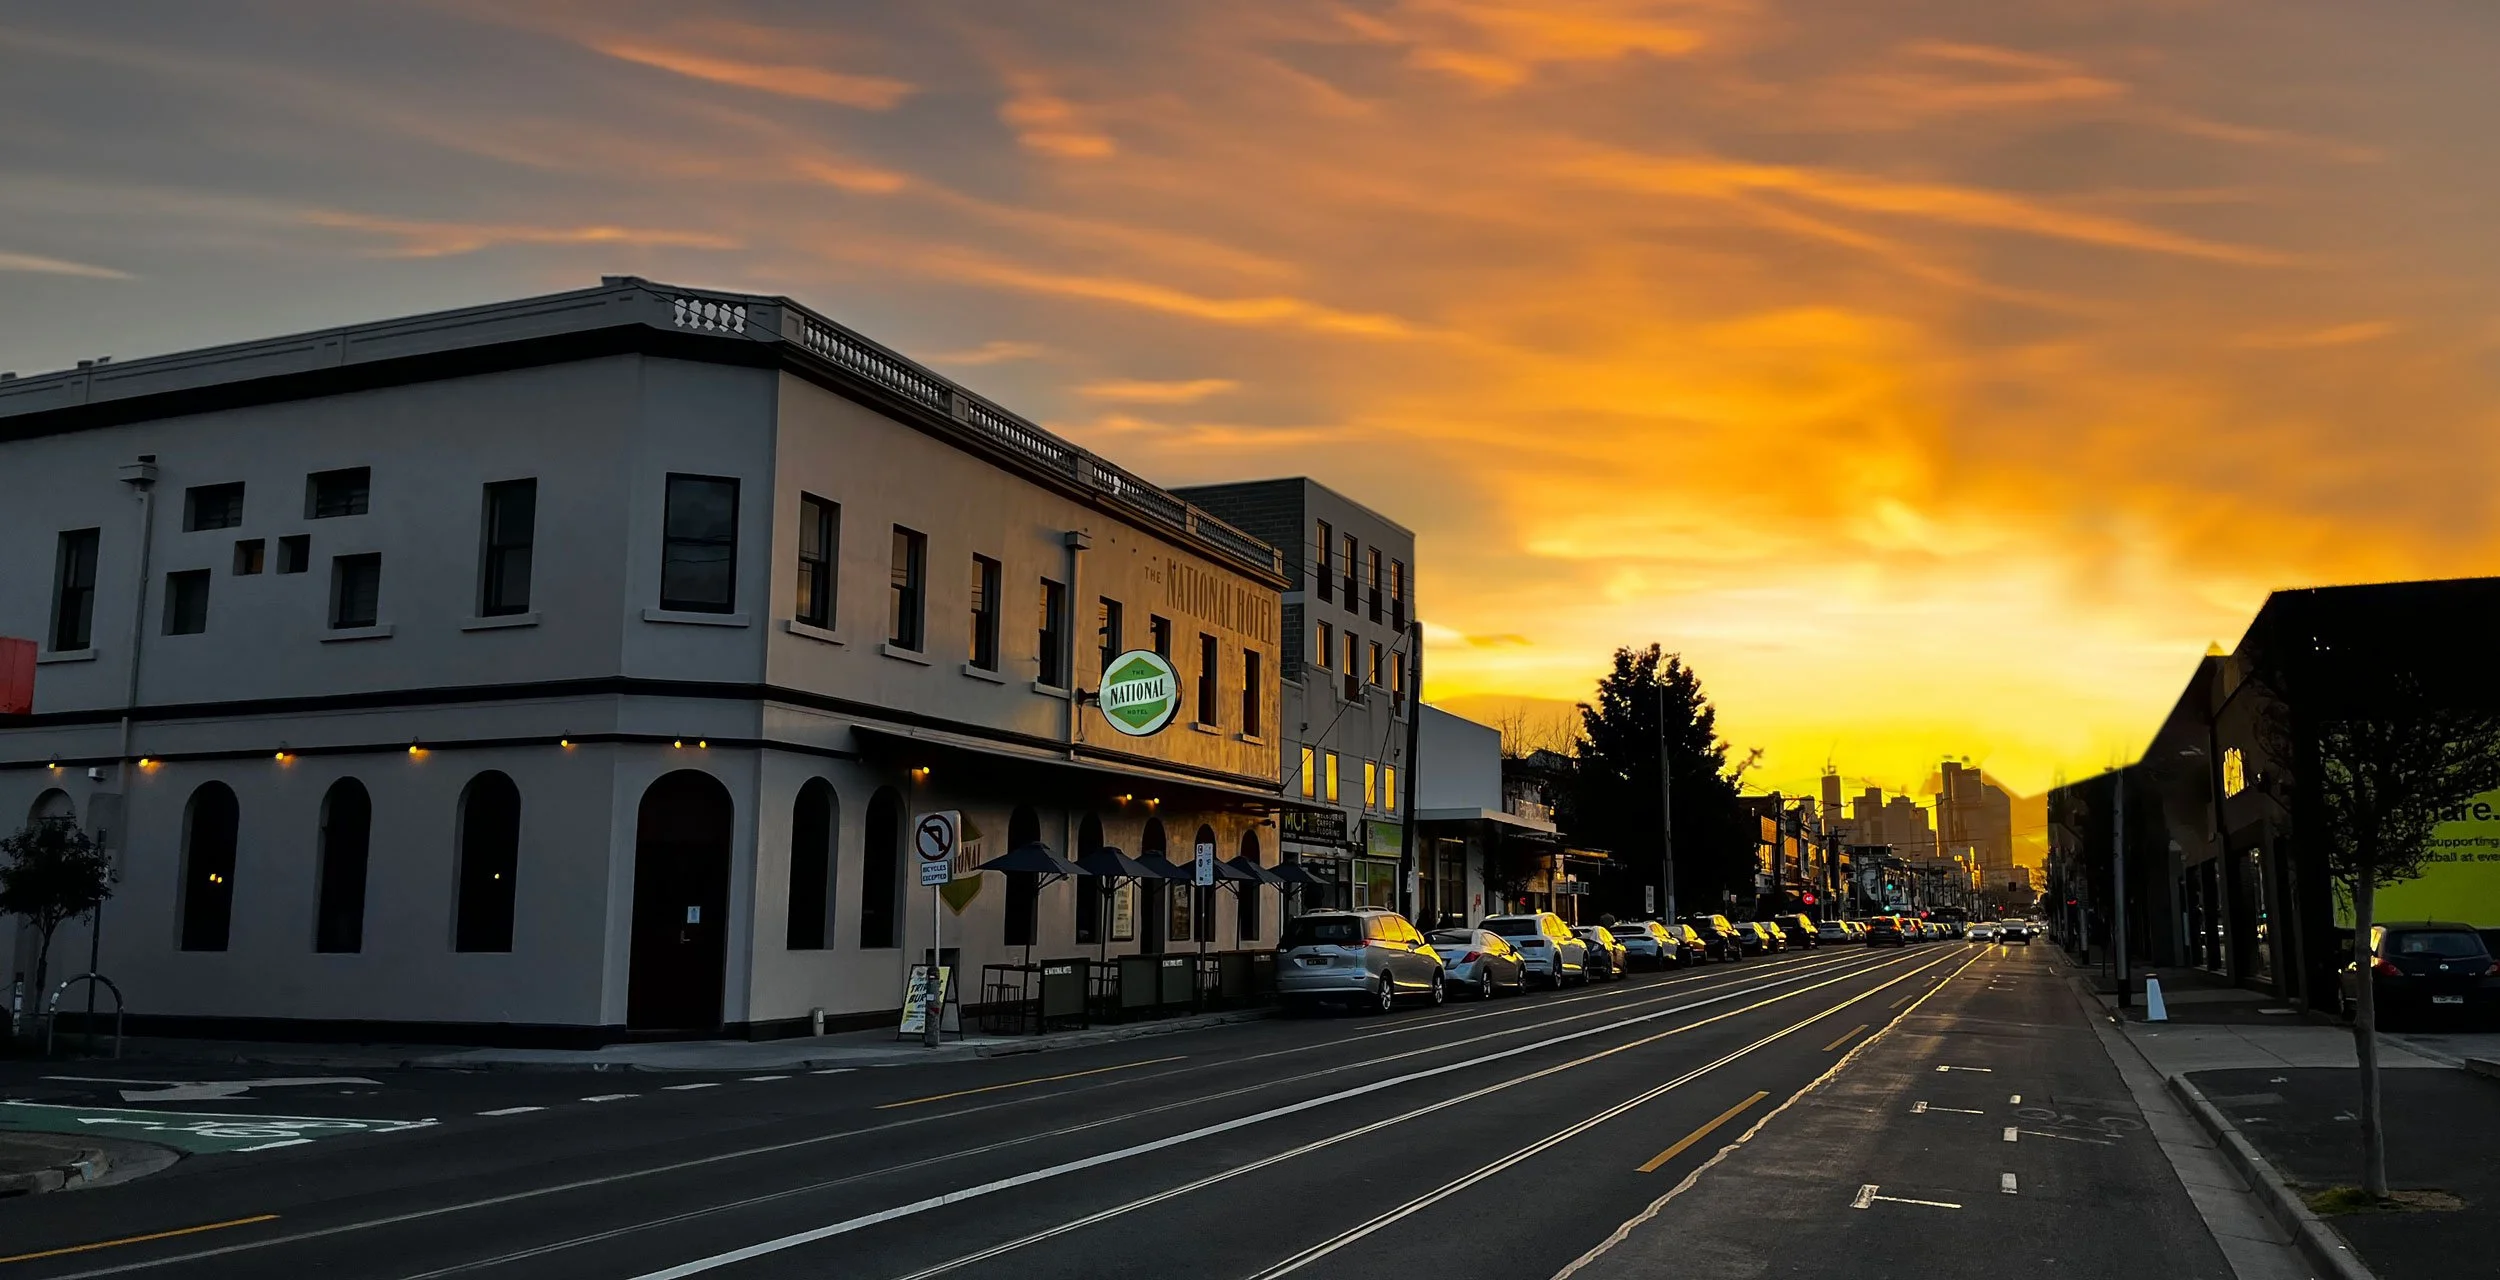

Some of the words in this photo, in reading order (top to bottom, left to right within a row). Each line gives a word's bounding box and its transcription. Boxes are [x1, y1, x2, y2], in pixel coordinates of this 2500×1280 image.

[1144, 566, 1161, 584] THE
[1166, 558, 1234, 631] NATIONAL
[1236, 587, 1275, 646] HOTEL
[1110, 678, 1166, 707] NATIONAL
[1126, 708, 1149, 716] HOTEL
[2477, 853, 2500, 862] eve
[922, 873, 947, 882] EXCEPTED
